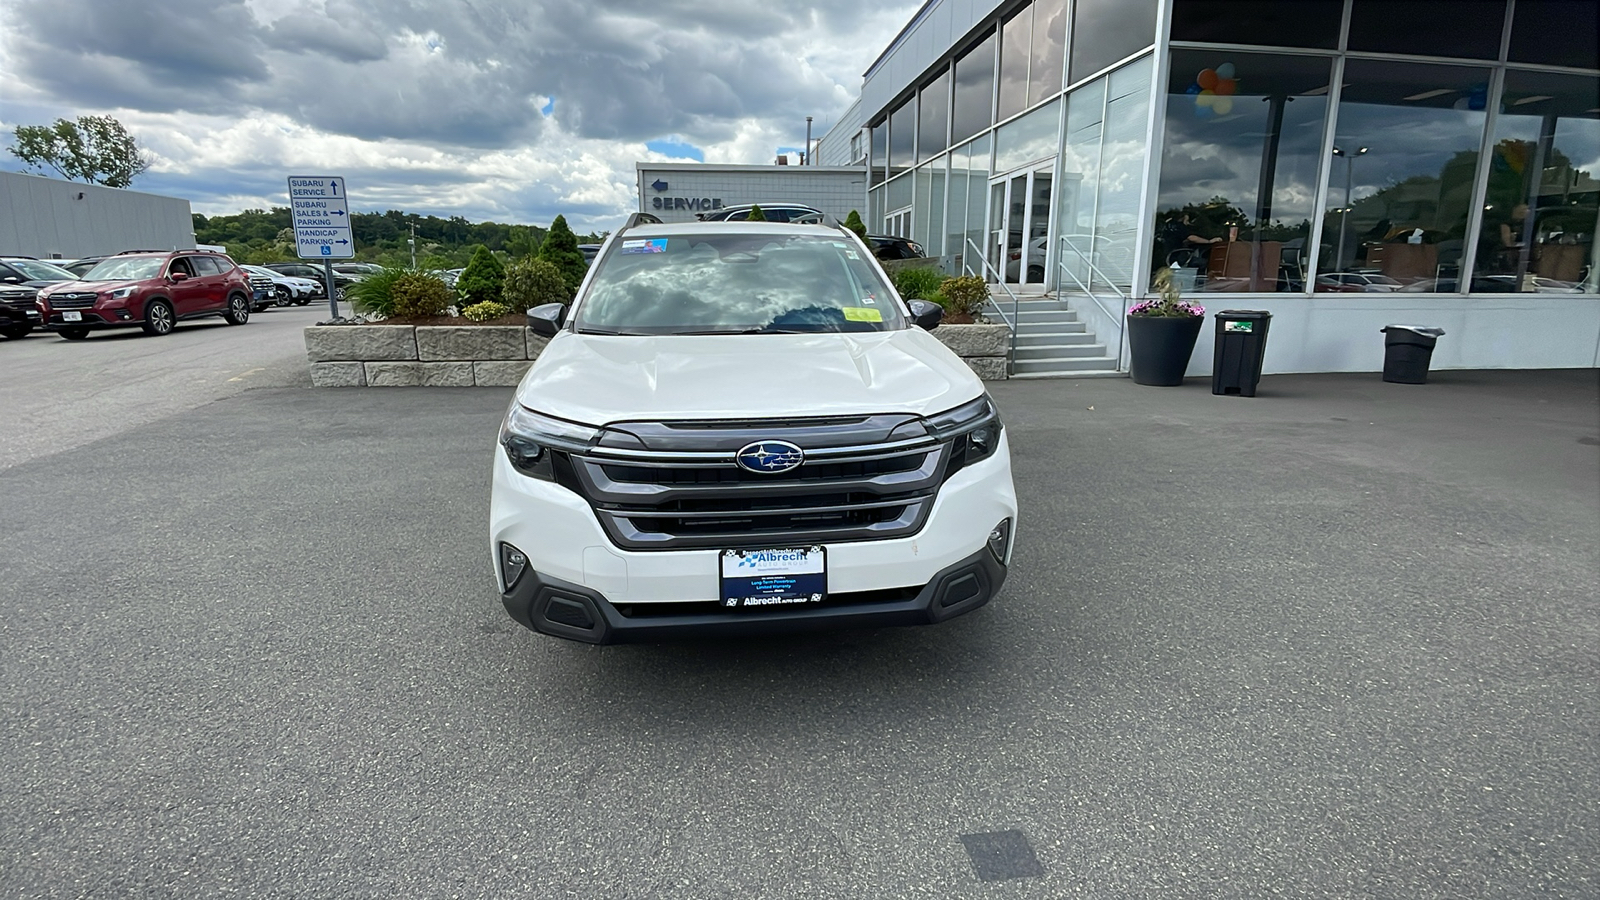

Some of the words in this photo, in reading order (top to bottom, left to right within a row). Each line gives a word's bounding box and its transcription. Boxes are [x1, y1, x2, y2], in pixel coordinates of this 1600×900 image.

[652, 196, 722, 211] SERVICE
[299, 229, 338, 237] HANDICAP
[758, 553, 808, 562] Albrecht
[744, 596, 782, 606] Albrecht
